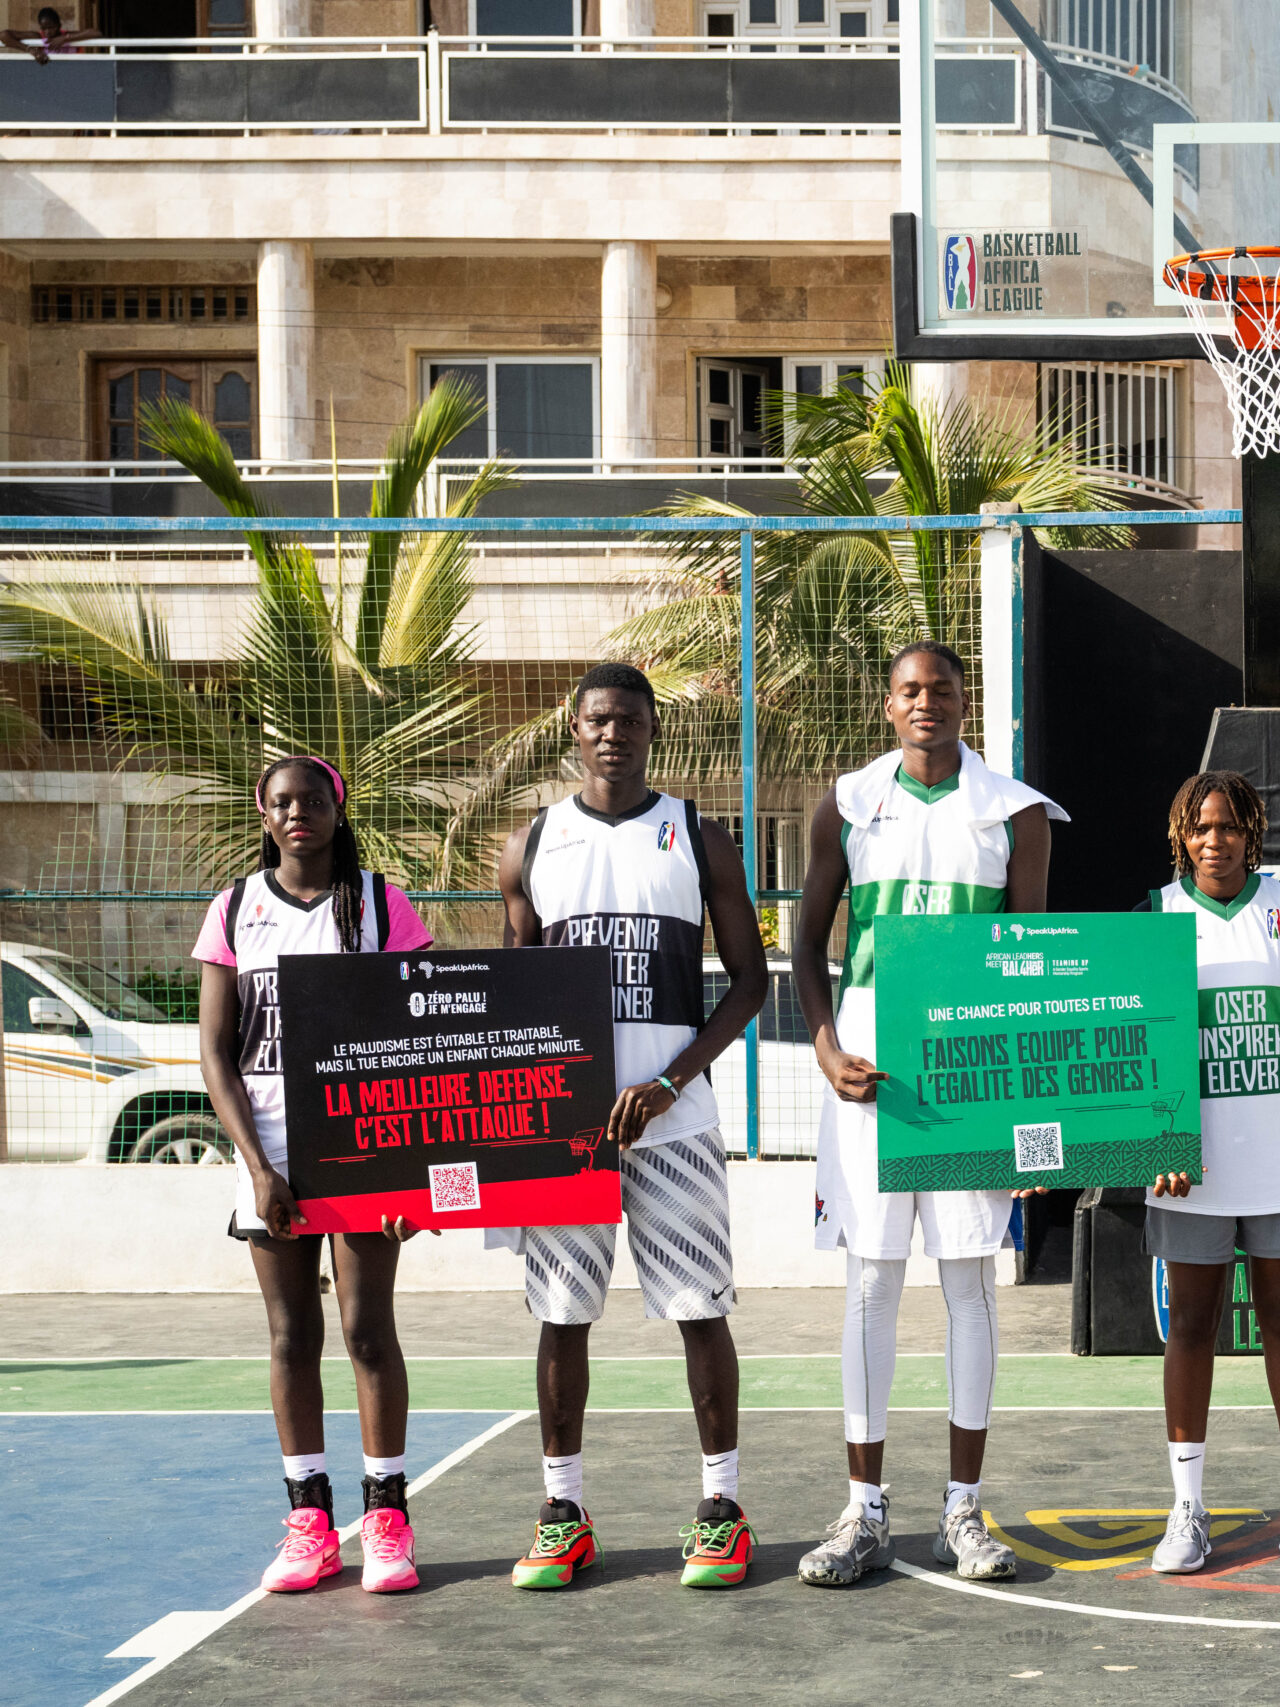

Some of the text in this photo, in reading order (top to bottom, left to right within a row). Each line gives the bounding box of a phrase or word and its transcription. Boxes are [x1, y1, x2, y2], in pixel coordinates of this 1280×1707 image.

[983, 232, 1081, 257] BASKETBALL
[947, 253, 955, 291] BAL
[983, 260, 1040, 285] AFRICA
[984, 287, 1043, 312] LEAGUE
[427, 990, 452, 1004] ZÉRO
[455, 992, 480, 1003] PALU
[428, 1003, 487, 1015] JE M'ENGAGE
[928, 995, 1144, 1022] UNE CHANCE POUR TOUTES ET TOUS.
[1215, 990, 1266, 1024] OSER
[315, 1039, 584, 1073] MAIS IL TUE ENCORE UN ENFANT CHAQUE MINUTE.
[333, 1025, 563, 1057] LE PALUDISME EST ÉVITABLE ET TRAITABLE,
[921, 1024, 1148, 1071] FAISONS EQUIPE POUR
[325, 1064, 573, 1117] LA MEILLEURE DEFENSE,
[916, 1058, 1159, 1106] L'EGALITE DES GENRES !
[1207, 1058, 1279, 1094] ELEVER
[355, 1102, 550, 1150] C'EST L'ATTAQUE !
